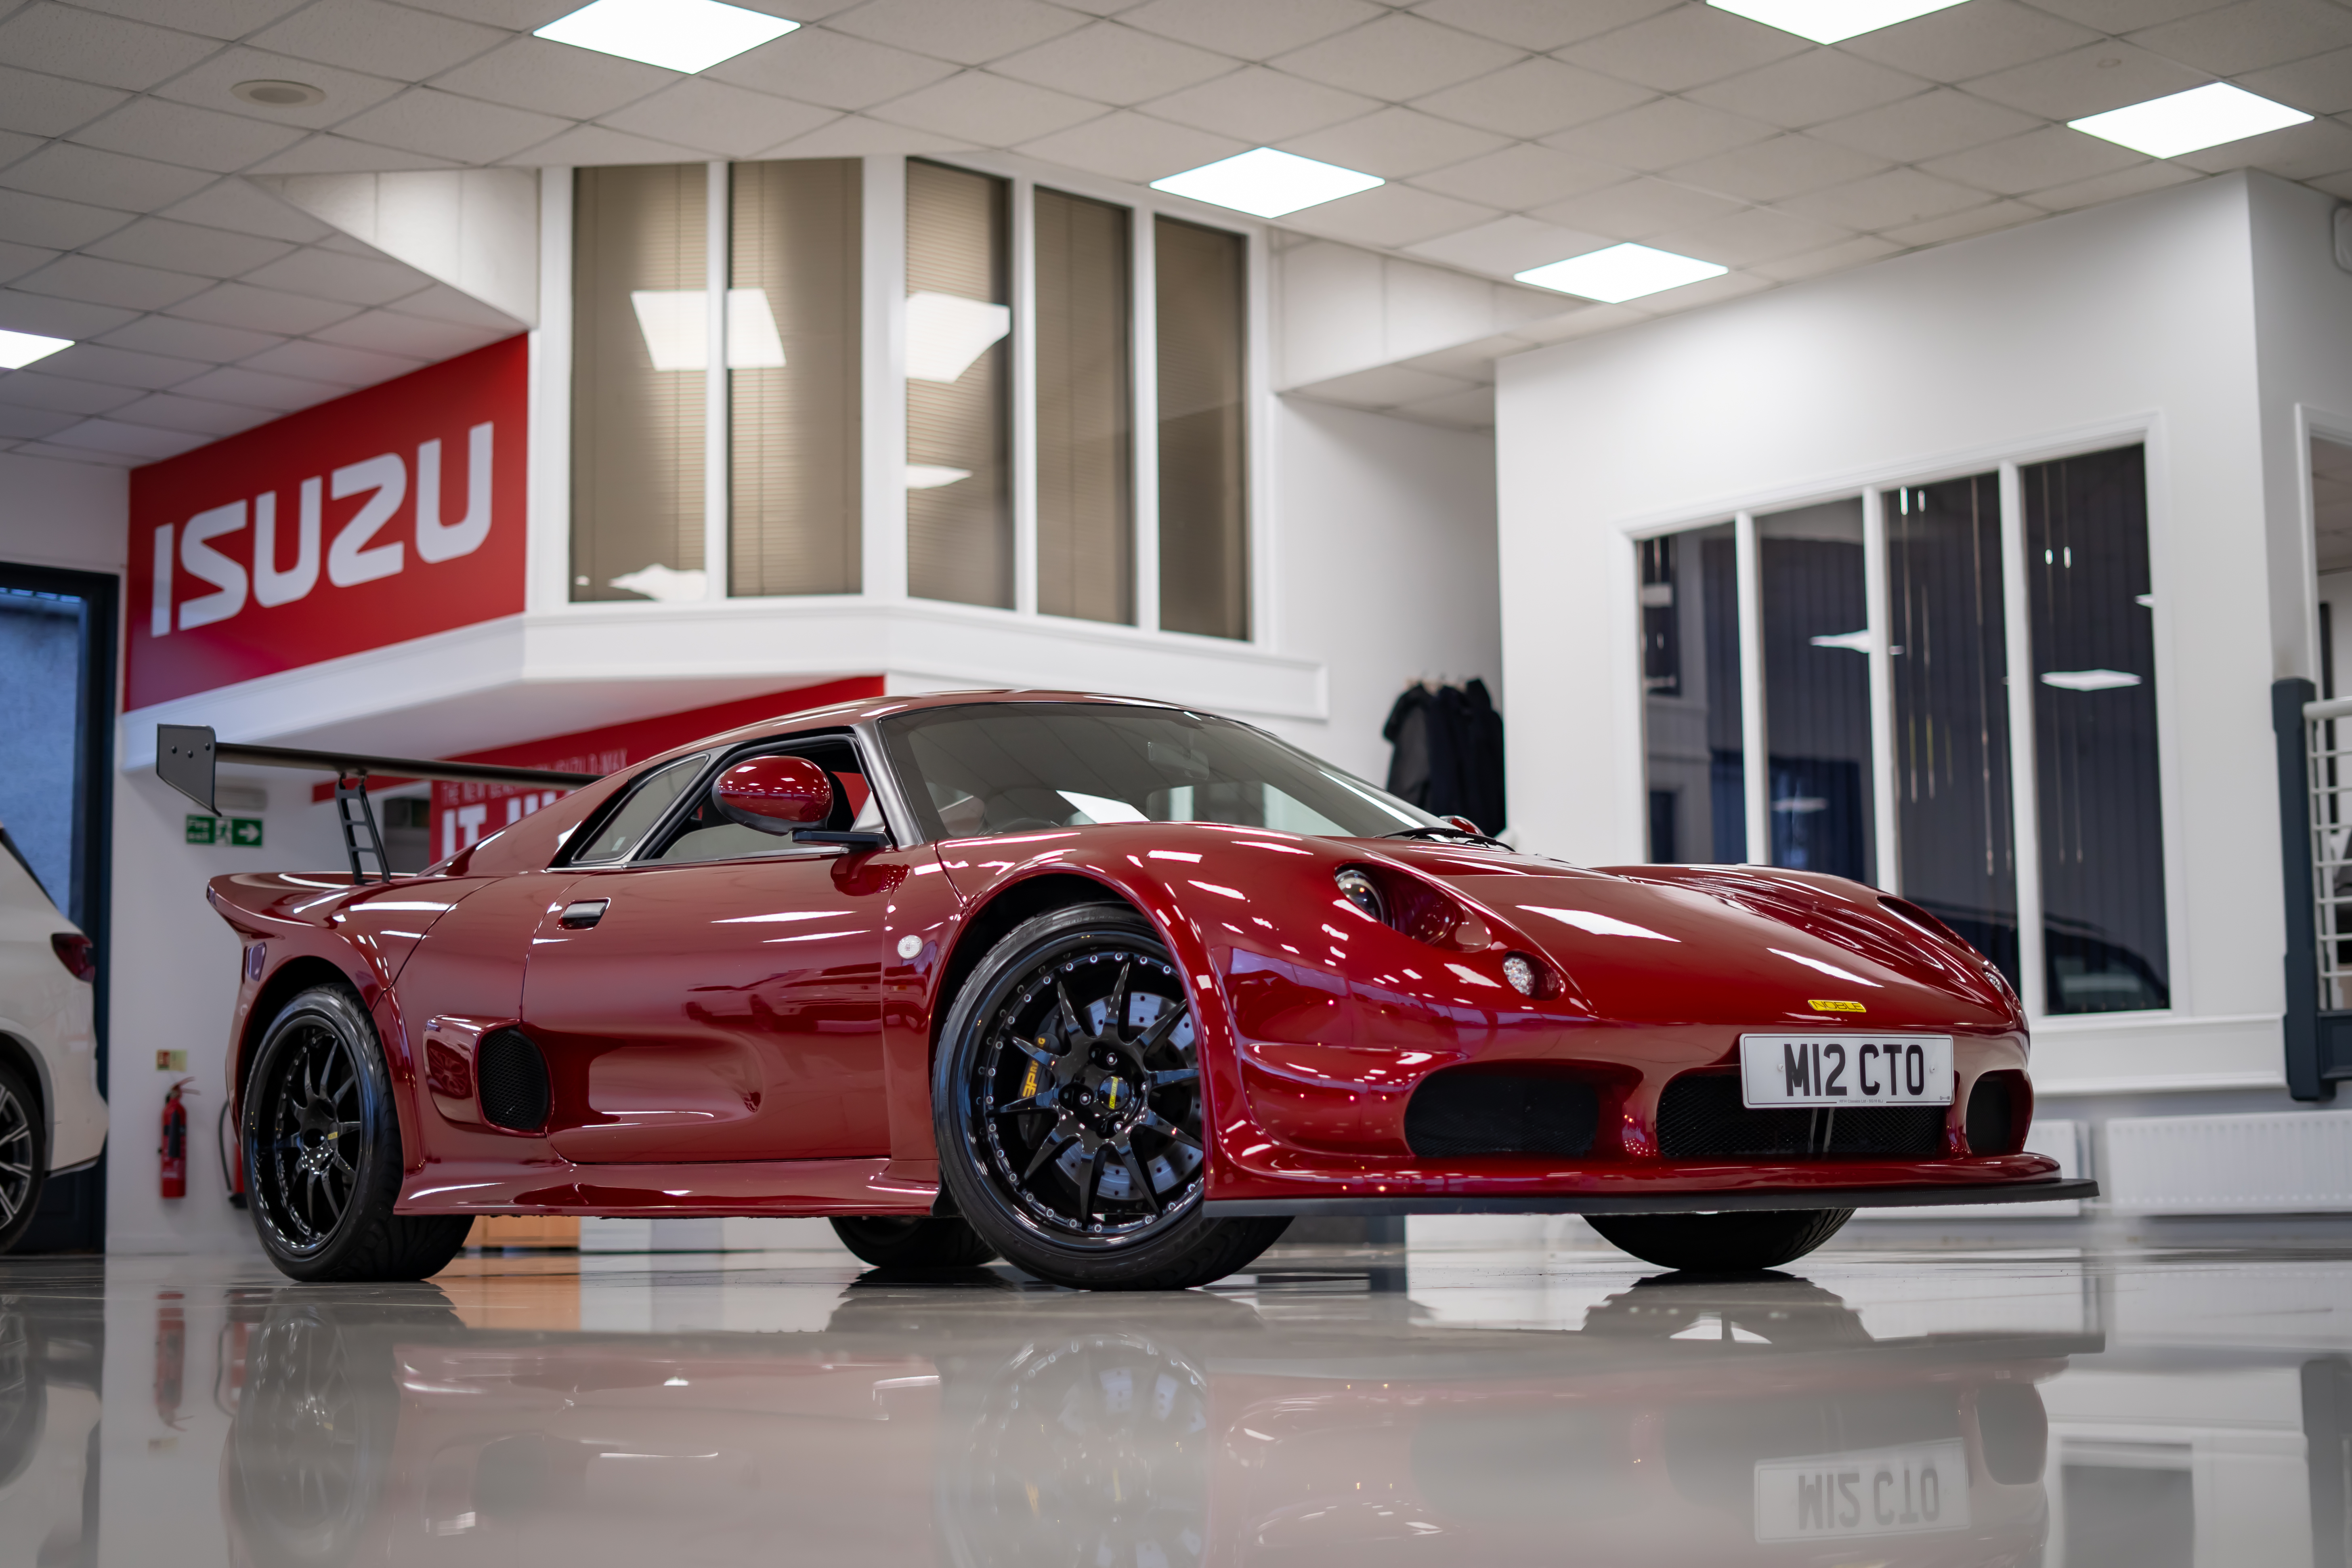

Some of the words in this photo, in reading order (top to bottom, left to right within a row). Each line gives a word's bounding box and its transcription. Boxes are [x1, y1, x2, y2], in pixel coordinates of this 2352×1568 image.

[151, 421, 494, 637] ISUZU
[1812, 1001, 1864, 1010] NOBLE
[1784, 1043, 1847, 1096] M12
[1859, 1043, 1924, 1096] CTO
